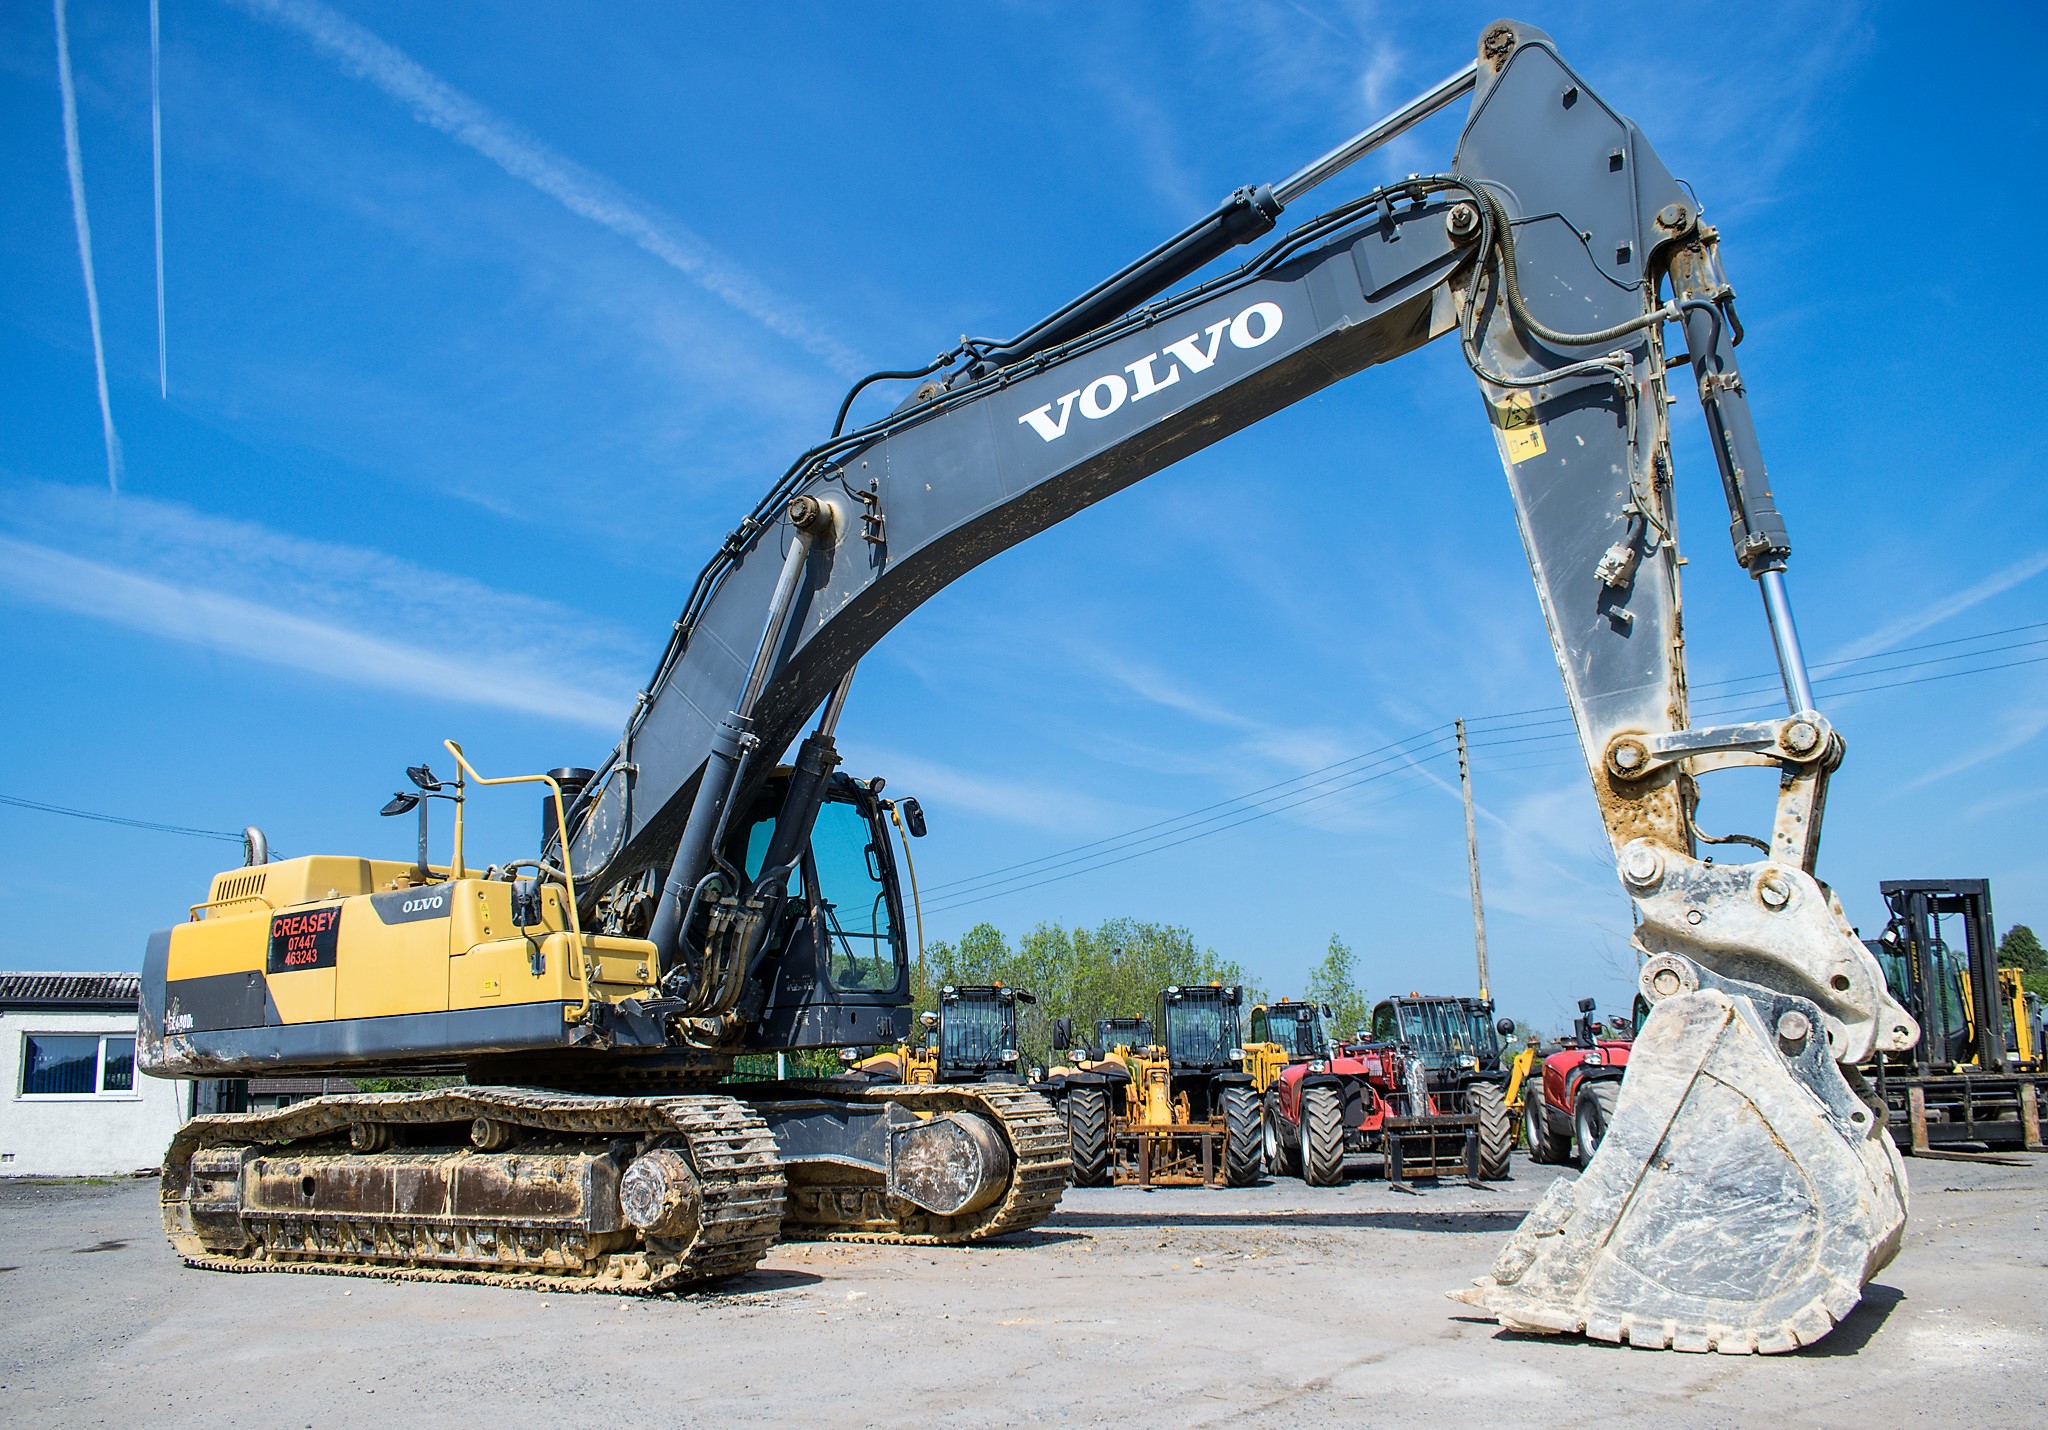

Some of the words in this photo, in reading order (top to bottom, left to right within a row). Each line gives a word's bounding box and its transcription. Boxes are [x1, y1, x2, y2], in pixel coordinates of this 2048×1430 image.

[1018, 302, 1283, 442] VOLVO
[402, 896, 443, 913] OLVO
[273, 911, 337, 938] CREASEY
[288, 934, 317, 951] 07447
[284, 948, 318, 966] 463243
[1910, 940, 1920, 983] HYSTER
